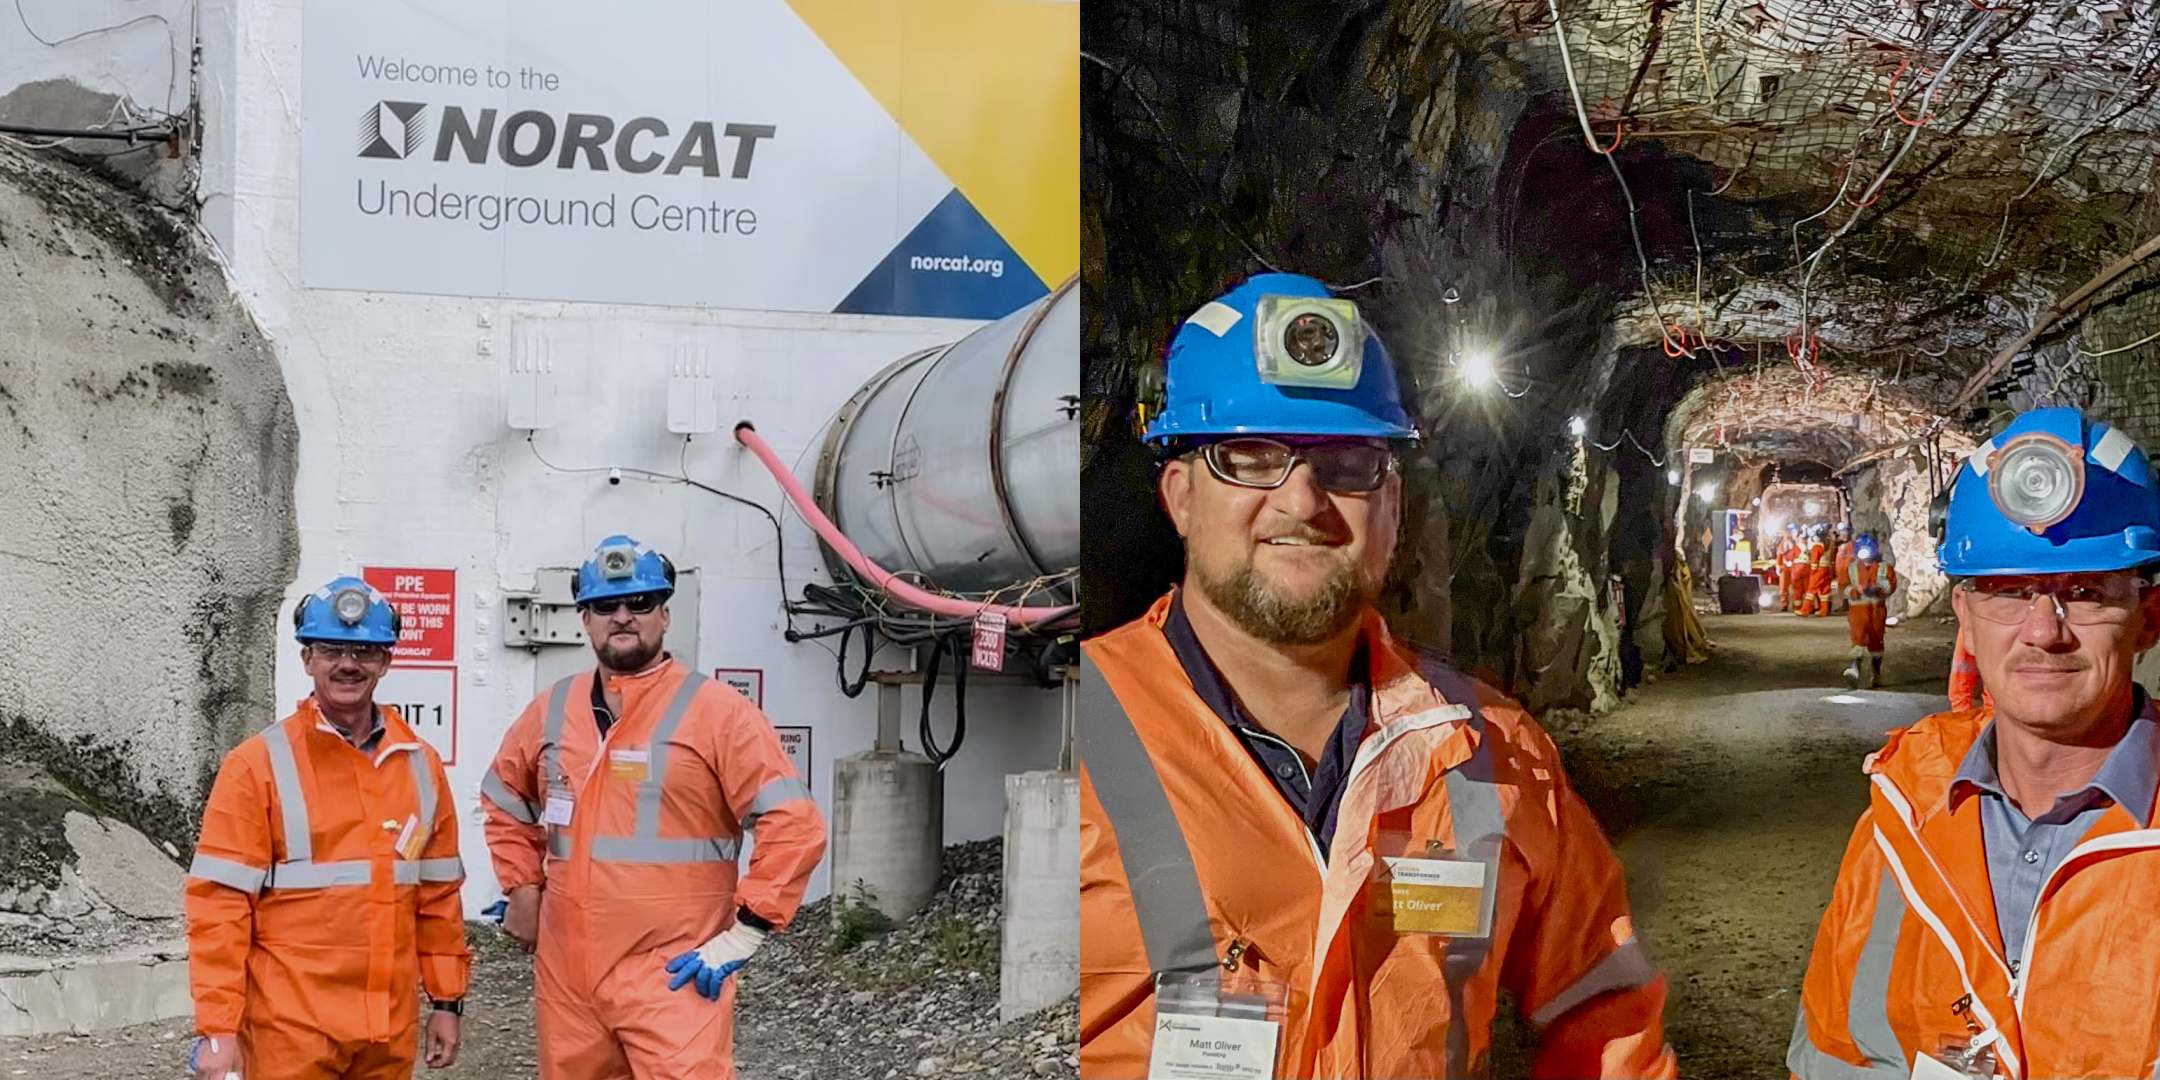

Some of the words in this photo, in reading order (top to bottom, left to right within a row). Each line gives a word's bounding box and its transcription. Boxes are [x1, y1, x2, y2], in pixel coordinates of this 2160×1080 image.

[357, 54, 478, 87] Welcome
[486, 65, 511, 89] to
[520, 67, 560, 91] the
[432, 105, 777, 179] NORCAT
[357, 179, 616, 231] Underground
[631, 194, 758, 236] Centre
[911, 255, 1004, 278] norcat.org
[395, 575, 424, 592] PPE
[401, 603, 416, 614] BE
[417, 603, 450, 615] WORN
[401, 616, 417, 628] ND
[419, 616, 444, 628] THIS
[399, 629, 425, 641] OINT
[433, 704, 442, 726] 1
[780, 734, 801, 743] RING
[1392, 900, 1404, 910] tt
[1407, 899, 1443, 911] Oliver
[1190, 1039, 1212, 1050] Matt
[1215, 1040, 1242, 1052] Oliver
